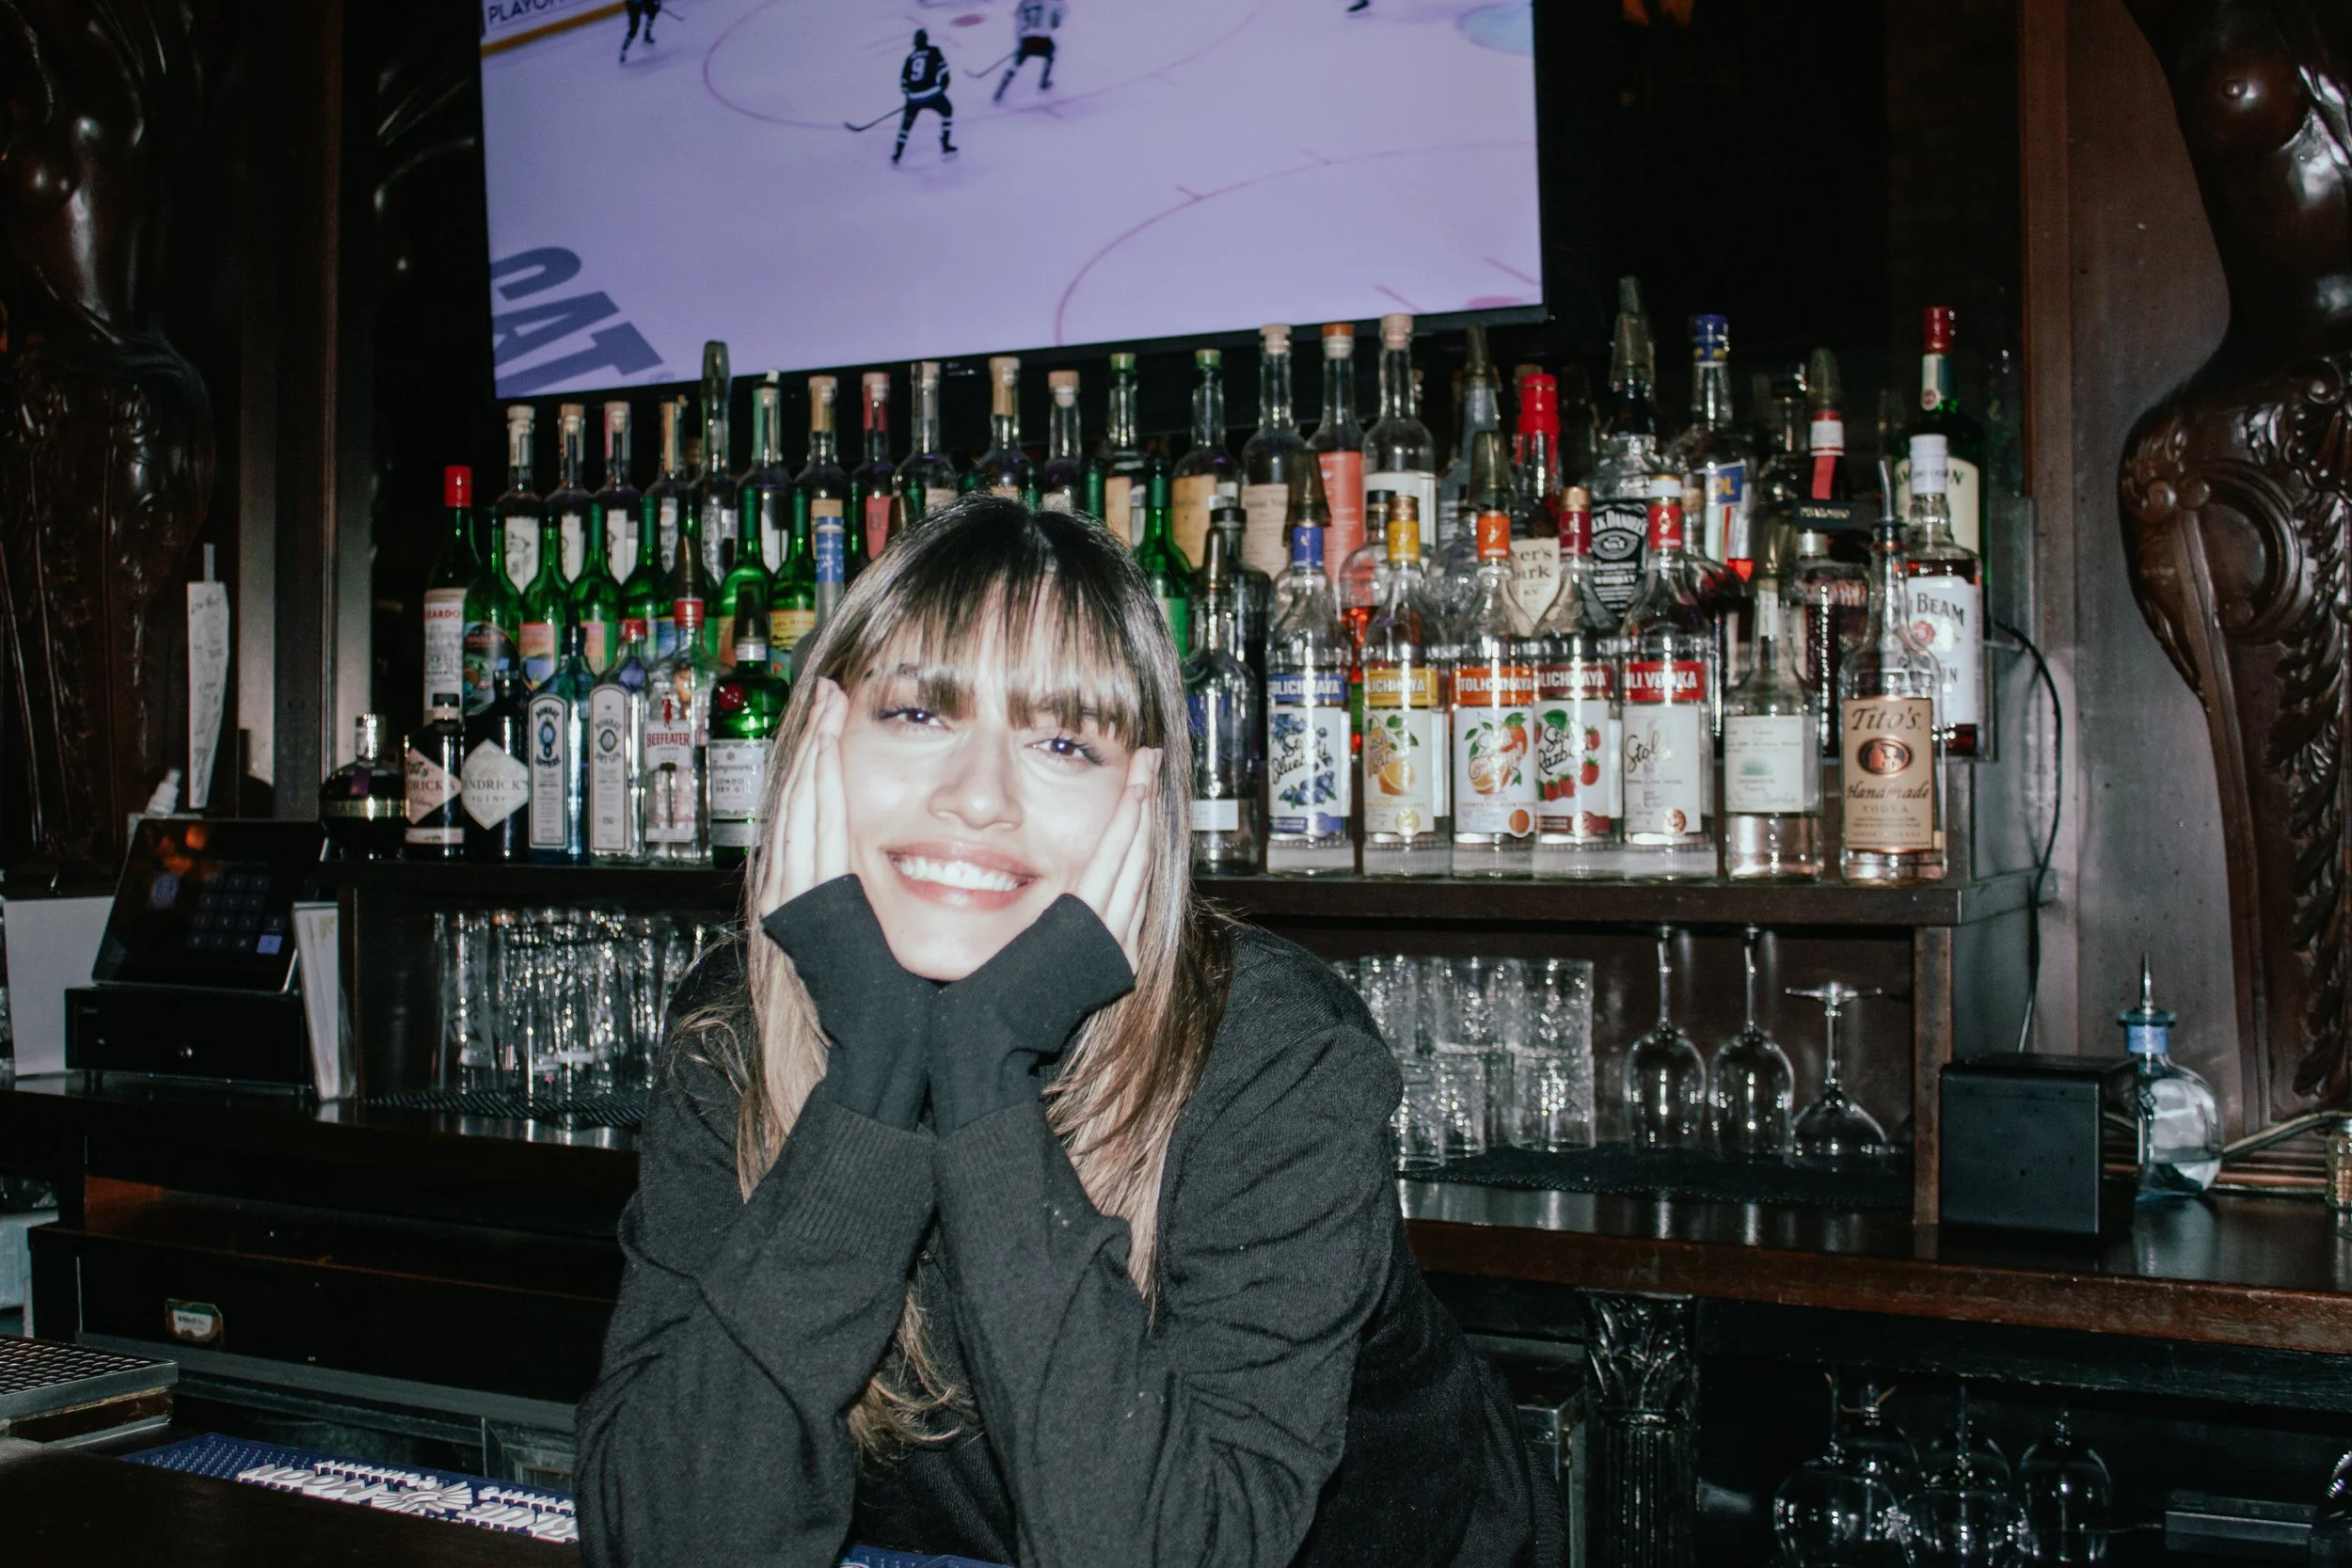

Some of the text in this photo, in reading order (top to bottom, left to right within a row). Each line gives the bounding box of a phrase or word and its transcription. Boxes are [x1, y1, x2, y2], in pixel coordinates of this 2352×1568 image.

[1511, 546, 1552, 562] ker's
[1516, 563, 1551, 580] ark
[1916, 593, 1964, 626] BEAM
[1851, 707, 1921, 731] Tito's
[646, 733, 691, 748] BEEFEATER
